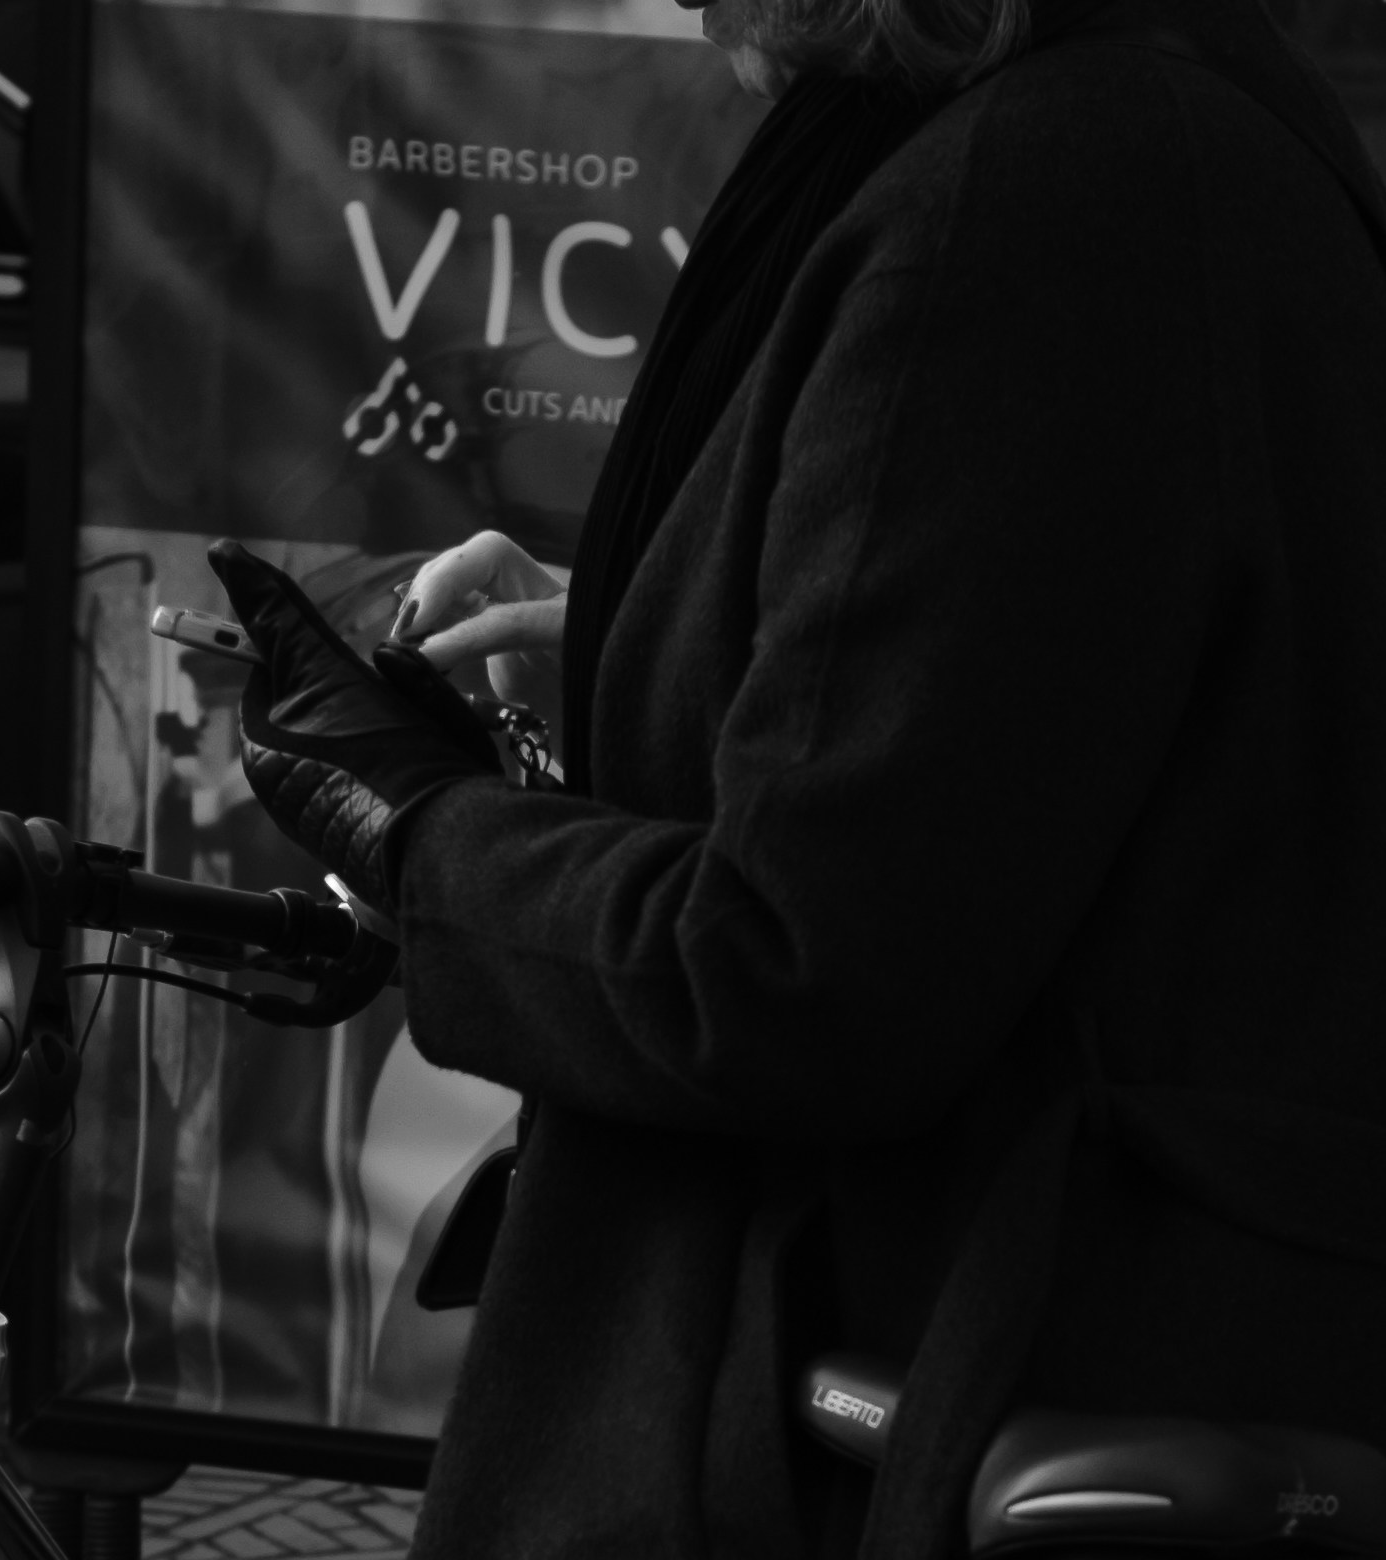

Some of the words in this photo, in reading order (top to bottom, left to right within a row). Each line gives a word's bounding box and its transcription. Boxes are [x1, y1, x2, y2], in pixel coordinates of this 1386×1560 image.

[347, 135, 640, 190] BARBERSHOP
[343, 200, 691, 359] VIC
[482, 386, 563, 421] CUTS
[812, 1384, 885, 1429] LIBERTO
